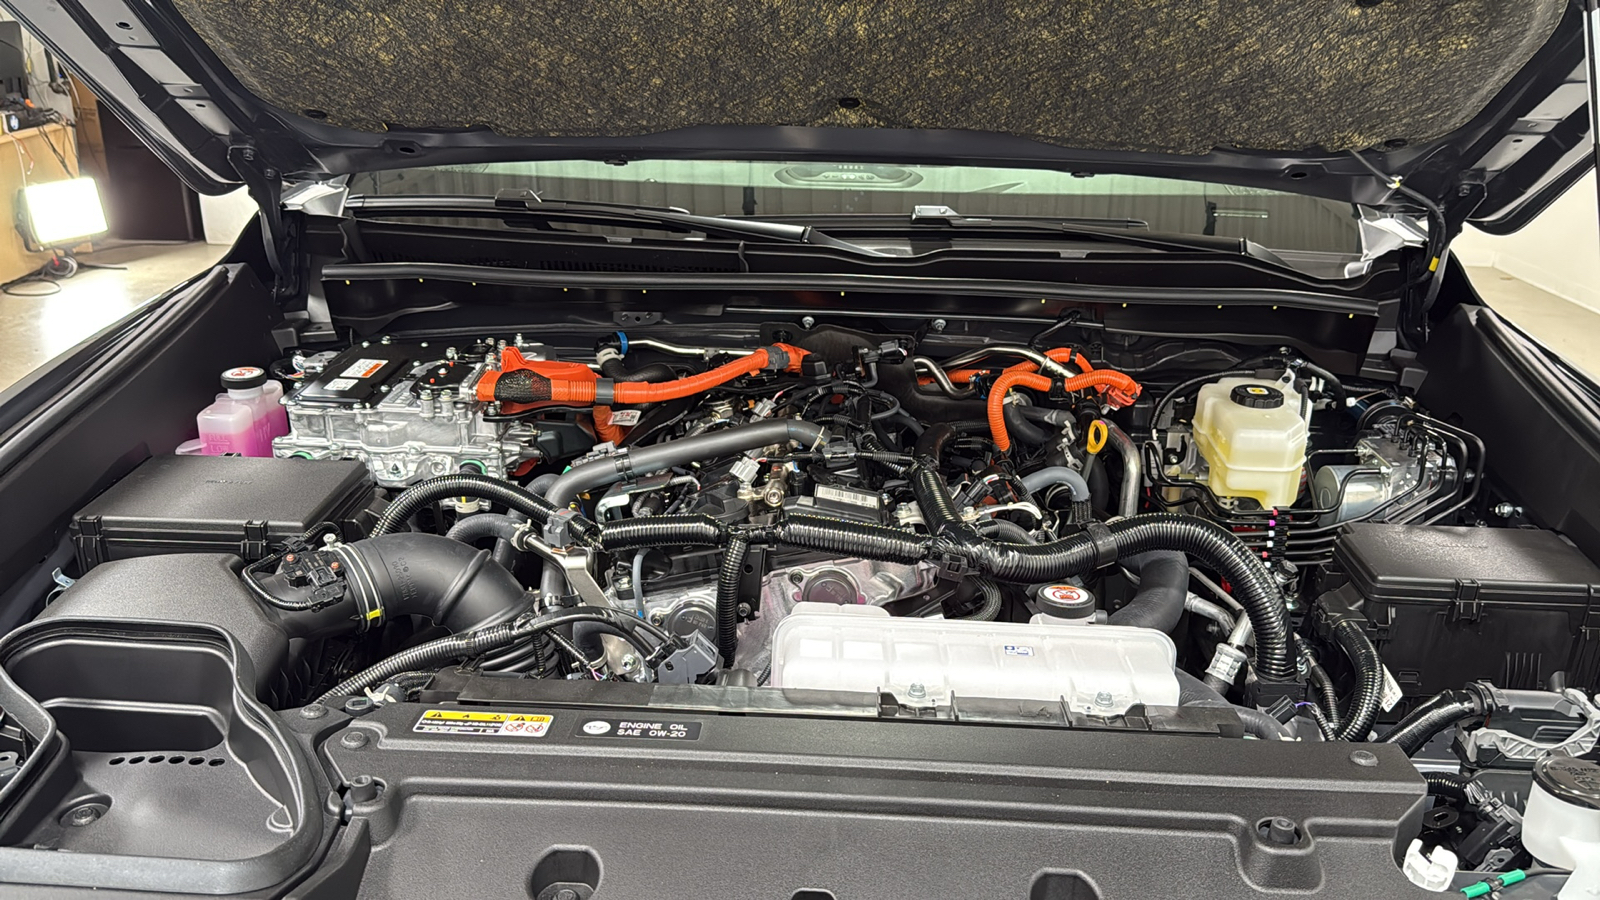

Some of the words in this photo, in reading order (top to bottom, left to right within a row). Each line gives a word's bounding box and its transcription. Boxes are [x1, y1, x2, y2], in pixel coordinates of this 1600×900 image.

[209, 433, 228, 441] FULL
[619, 721, 662, 730] ENGINE
[669, 723, 688, 731] OIL
